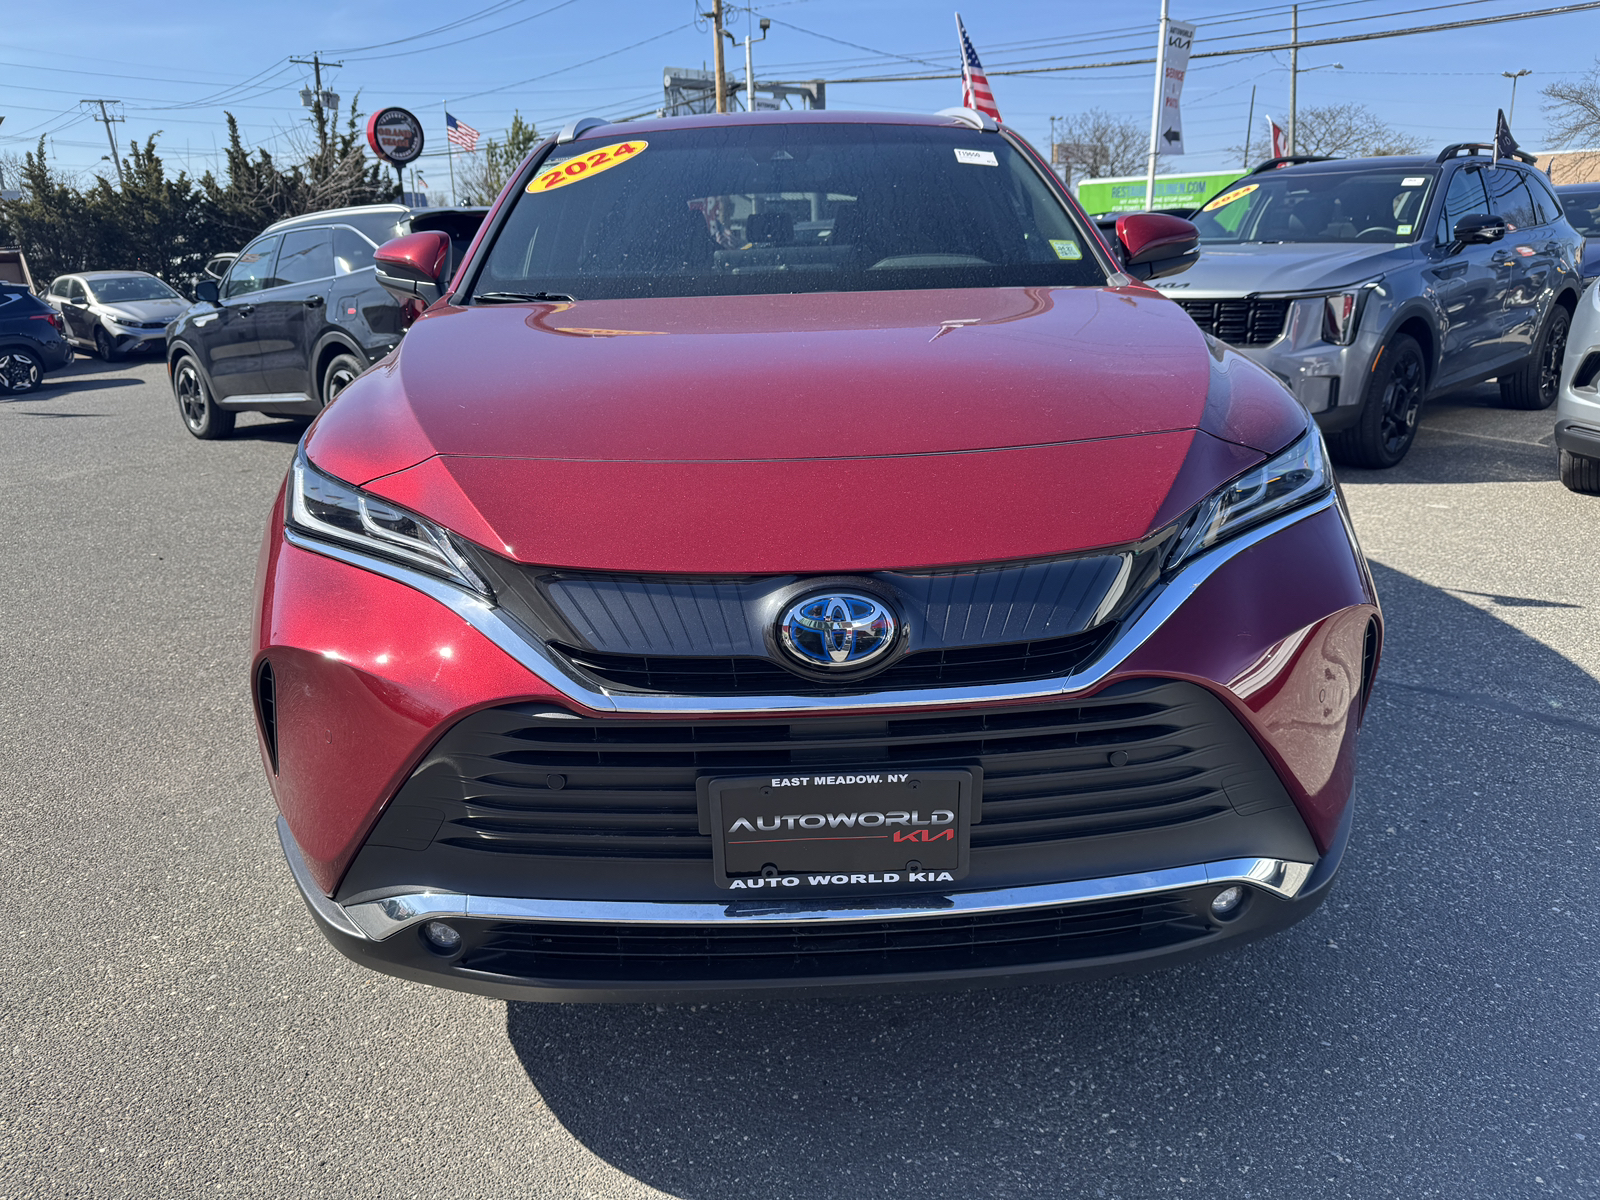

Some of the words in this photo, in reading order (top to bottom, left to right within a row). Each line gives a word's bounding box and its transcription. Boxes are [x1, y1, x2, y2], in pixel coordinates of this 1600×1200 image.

[1169, 36, 1191, 50] KIA
[1166, 67, 1185, 82] SERVICE
[541, 143, 637, 189] 2024
[771, 777, 810, 788] EAST
[887, 773, 909, 784] NY
[728, 809, 954, 833] AUTOWORLD
[893, 828, 954, 843] KIA
[729, 876, 800, 890] AUTO
[807, 872, 900, 886] WORLD
[908, 871, 954, 882] KIA
